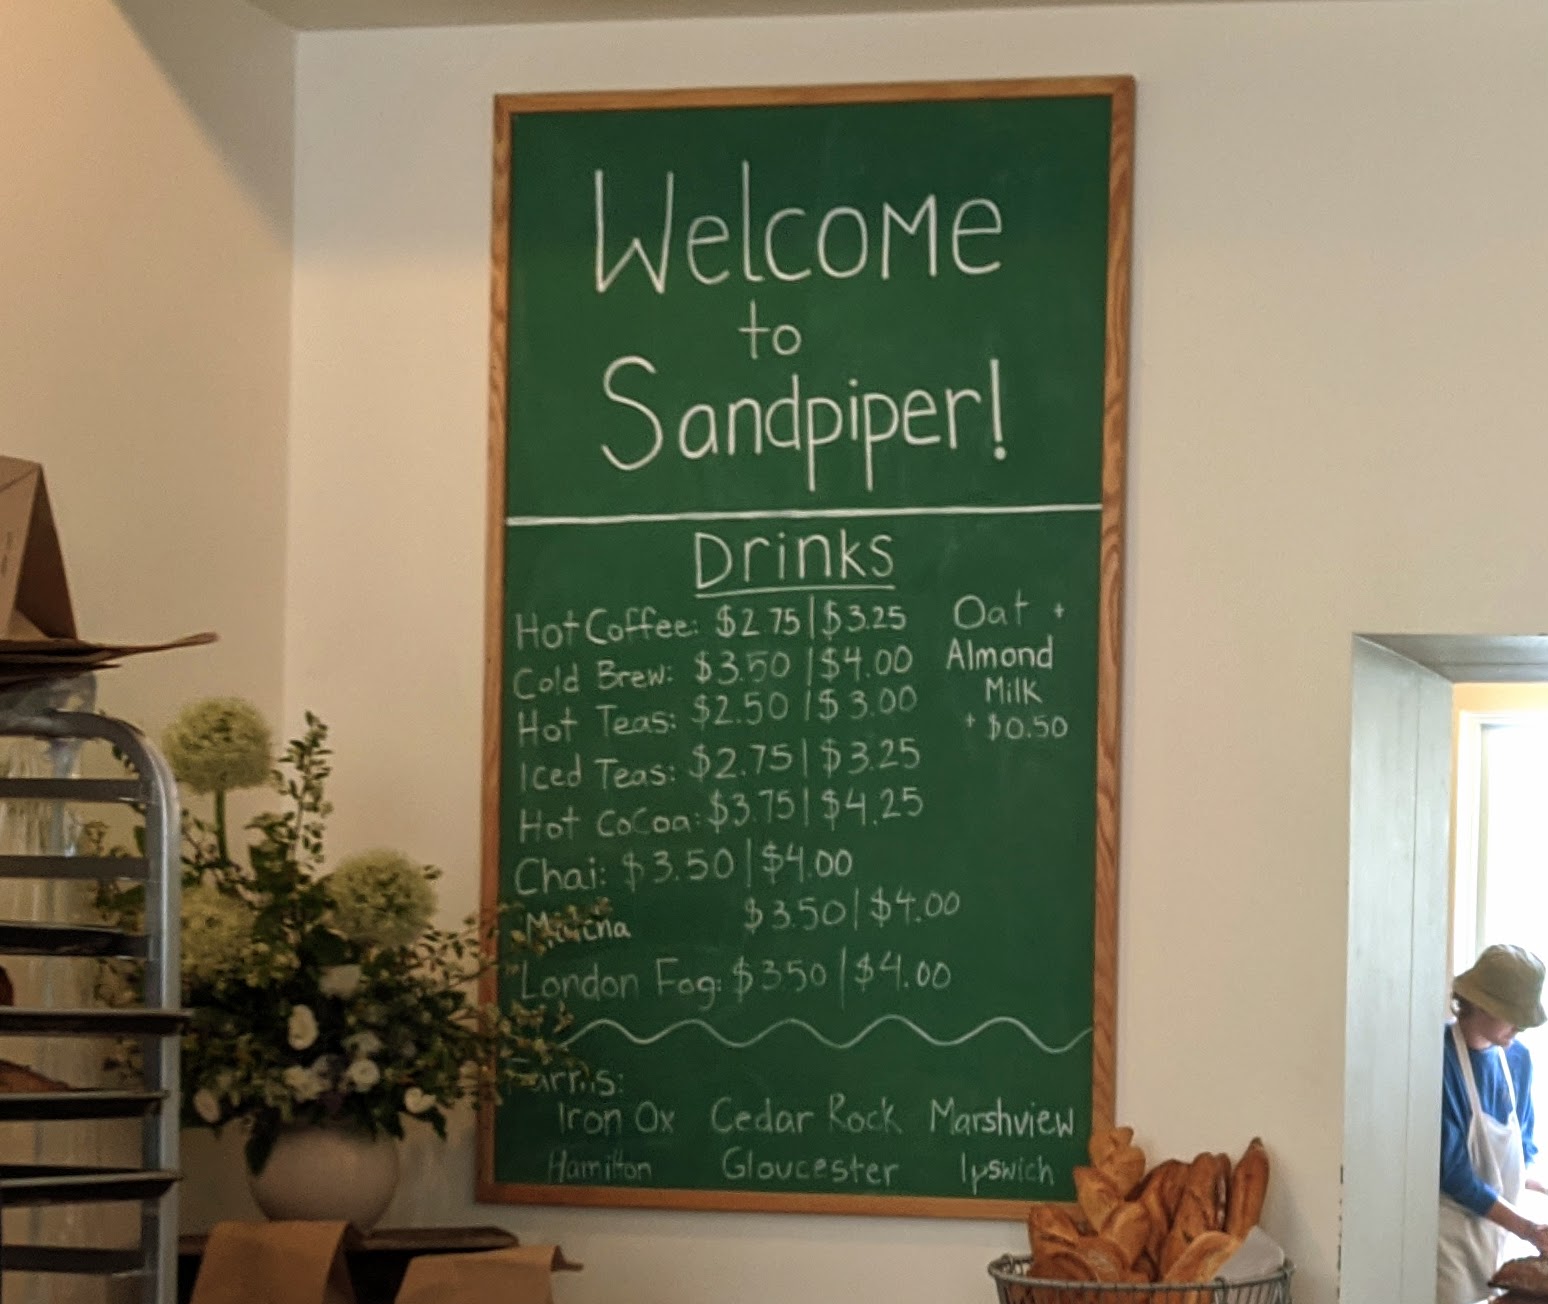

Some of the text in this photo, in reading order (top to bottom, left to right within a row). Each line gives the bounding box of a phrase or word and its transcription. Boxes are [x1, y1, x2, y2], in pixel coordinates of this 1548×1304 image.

[594, 159, 1002, 294] Welcome
[739, 299, 801, 359] to
[602, 356, 1006, 491] Sandpiper!
[694, 528, 893, 590] Drinks
[515, 609, 580, 650] Hot
[585, 605, 699, 646] Coffee:
[954, 589, 1030, 631] Oat
[946, 634, 1053, 671] Almond
[513, 662, 580, 700] Cold
[596, 659, 674, 691] Brew:
[985, 677, 1043, 705] Milk
[518, 706, 578, 748] Hot
[595, 704, 677, 737] Teas:
[521, 752, 582, 792] Iced
[593, 757, 676, 791] Teas:
[519, 805, 581, 844] Hot
[514, 855, 606, 896] Chai:
[520, 959, 639, 1001] London
[656, 957, 722, 1011] Fog:
[558, 1100, 676, 1138] Iron Ox
[711, 1091, 902, 1136] Cedar Rock
[930, 1096, 1074, 1139] Marshview
[548, 1147, 653, 1184] Hamilton
[721, 1145, 900, 1188] Gloucester
[961, 1151, 1056, 1196] Ipswich
